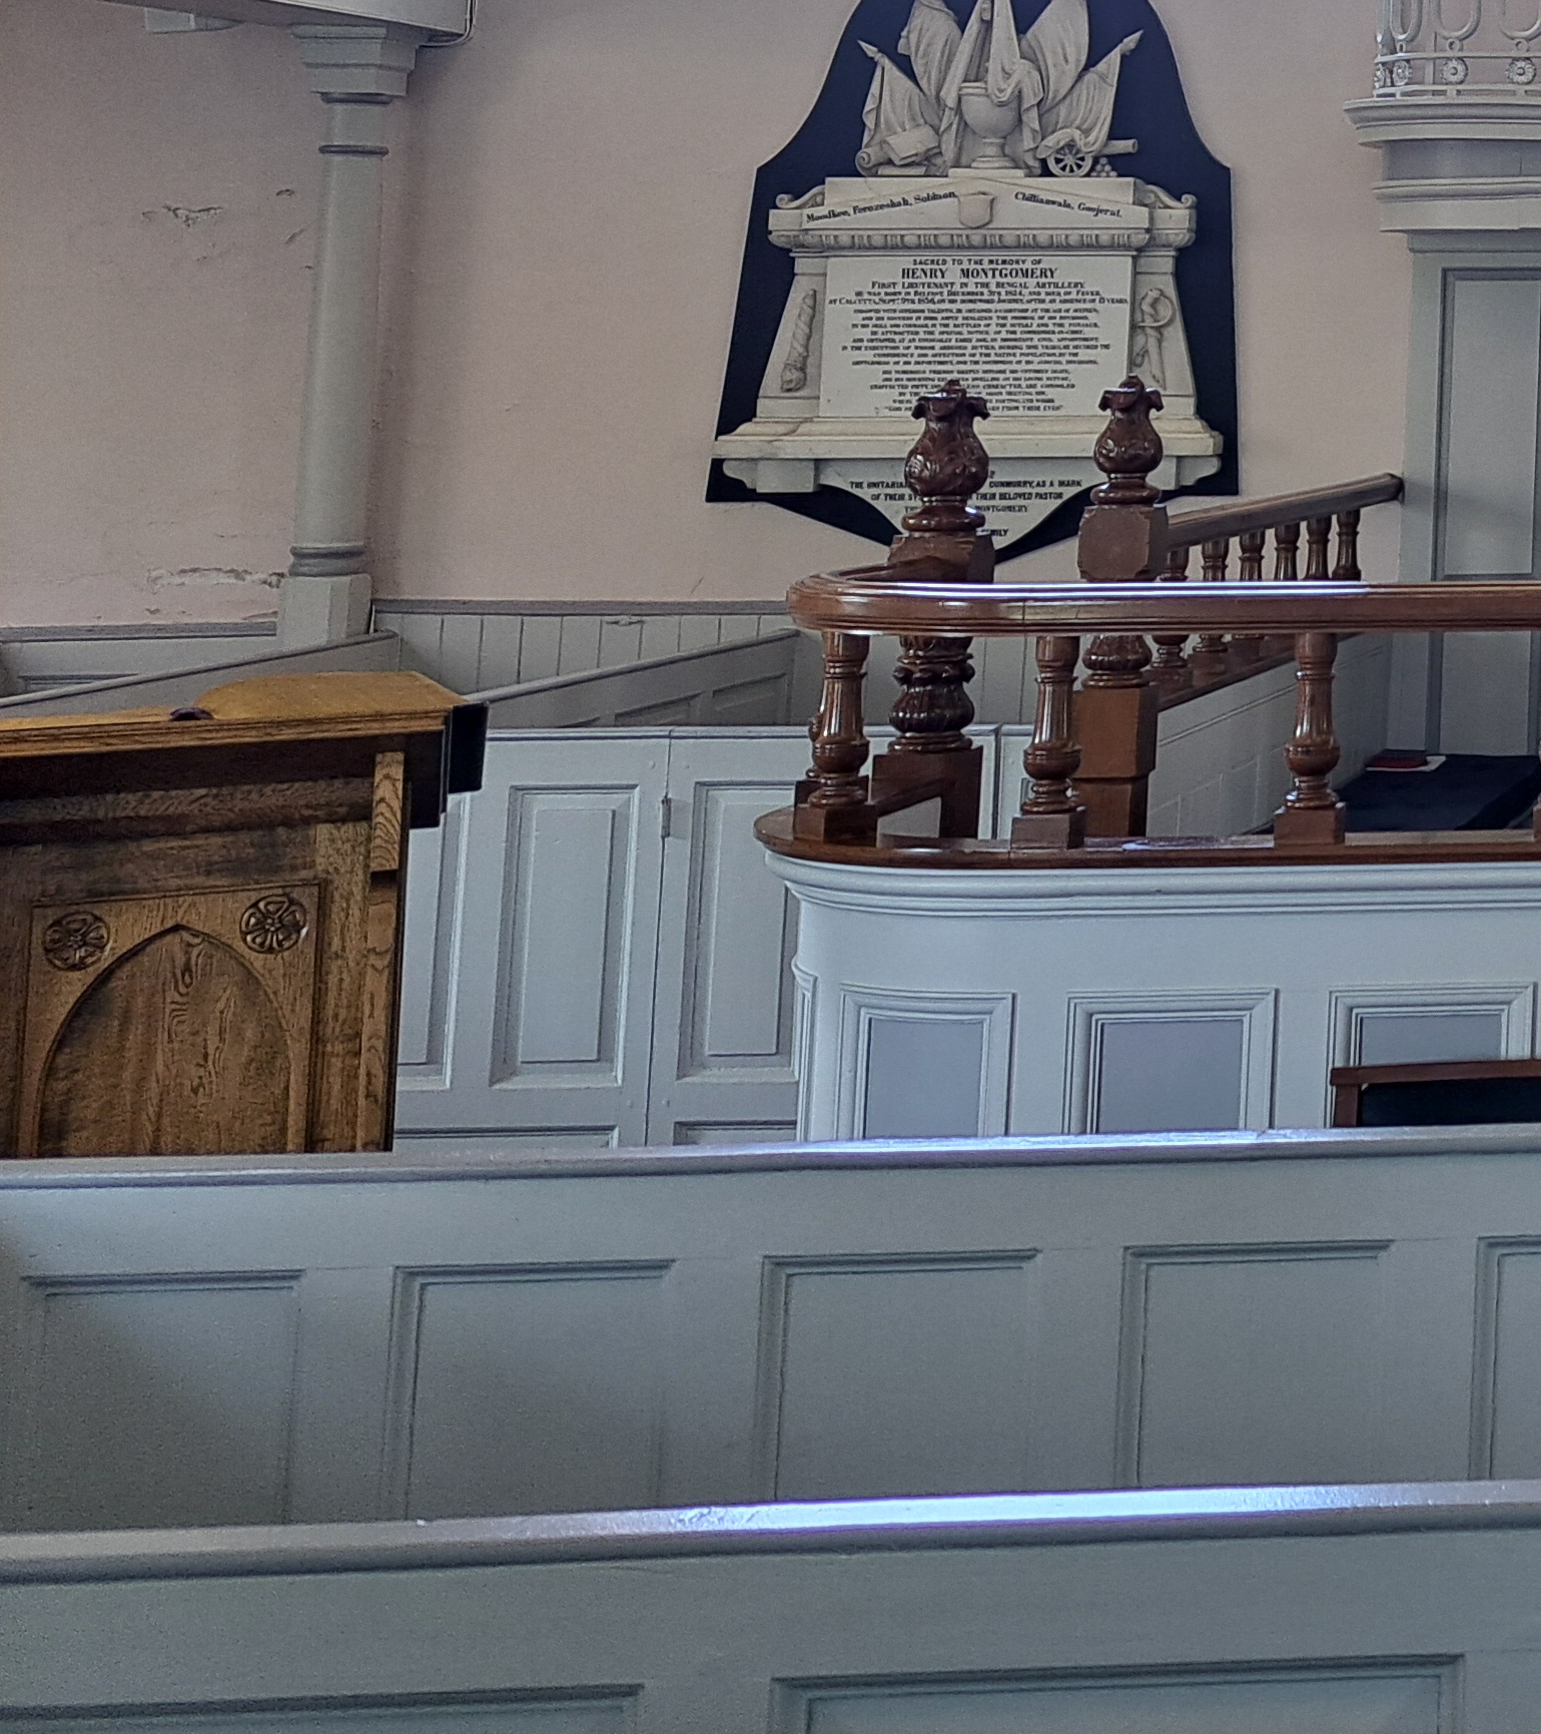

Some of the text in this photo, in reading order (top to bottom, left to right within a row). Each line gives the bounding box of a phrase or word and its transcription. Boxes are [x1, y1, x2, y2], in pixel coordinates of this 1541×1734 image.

[902, 268, 1057, 279] HENRY MONTGOMERY
[872, 281, 897, 289] FIRST
[960, 281, 968, 289] IN
[974, 281, 990, 289] THE
[996, 281, 1028, 289] BENGAL
[850, 481, 863, 489] THE
[867, 481, 906, 489] UNITARIA
[999, 492, 1032, 500] BELOVED
[1035, 492, 1063, 500] PASTOR
